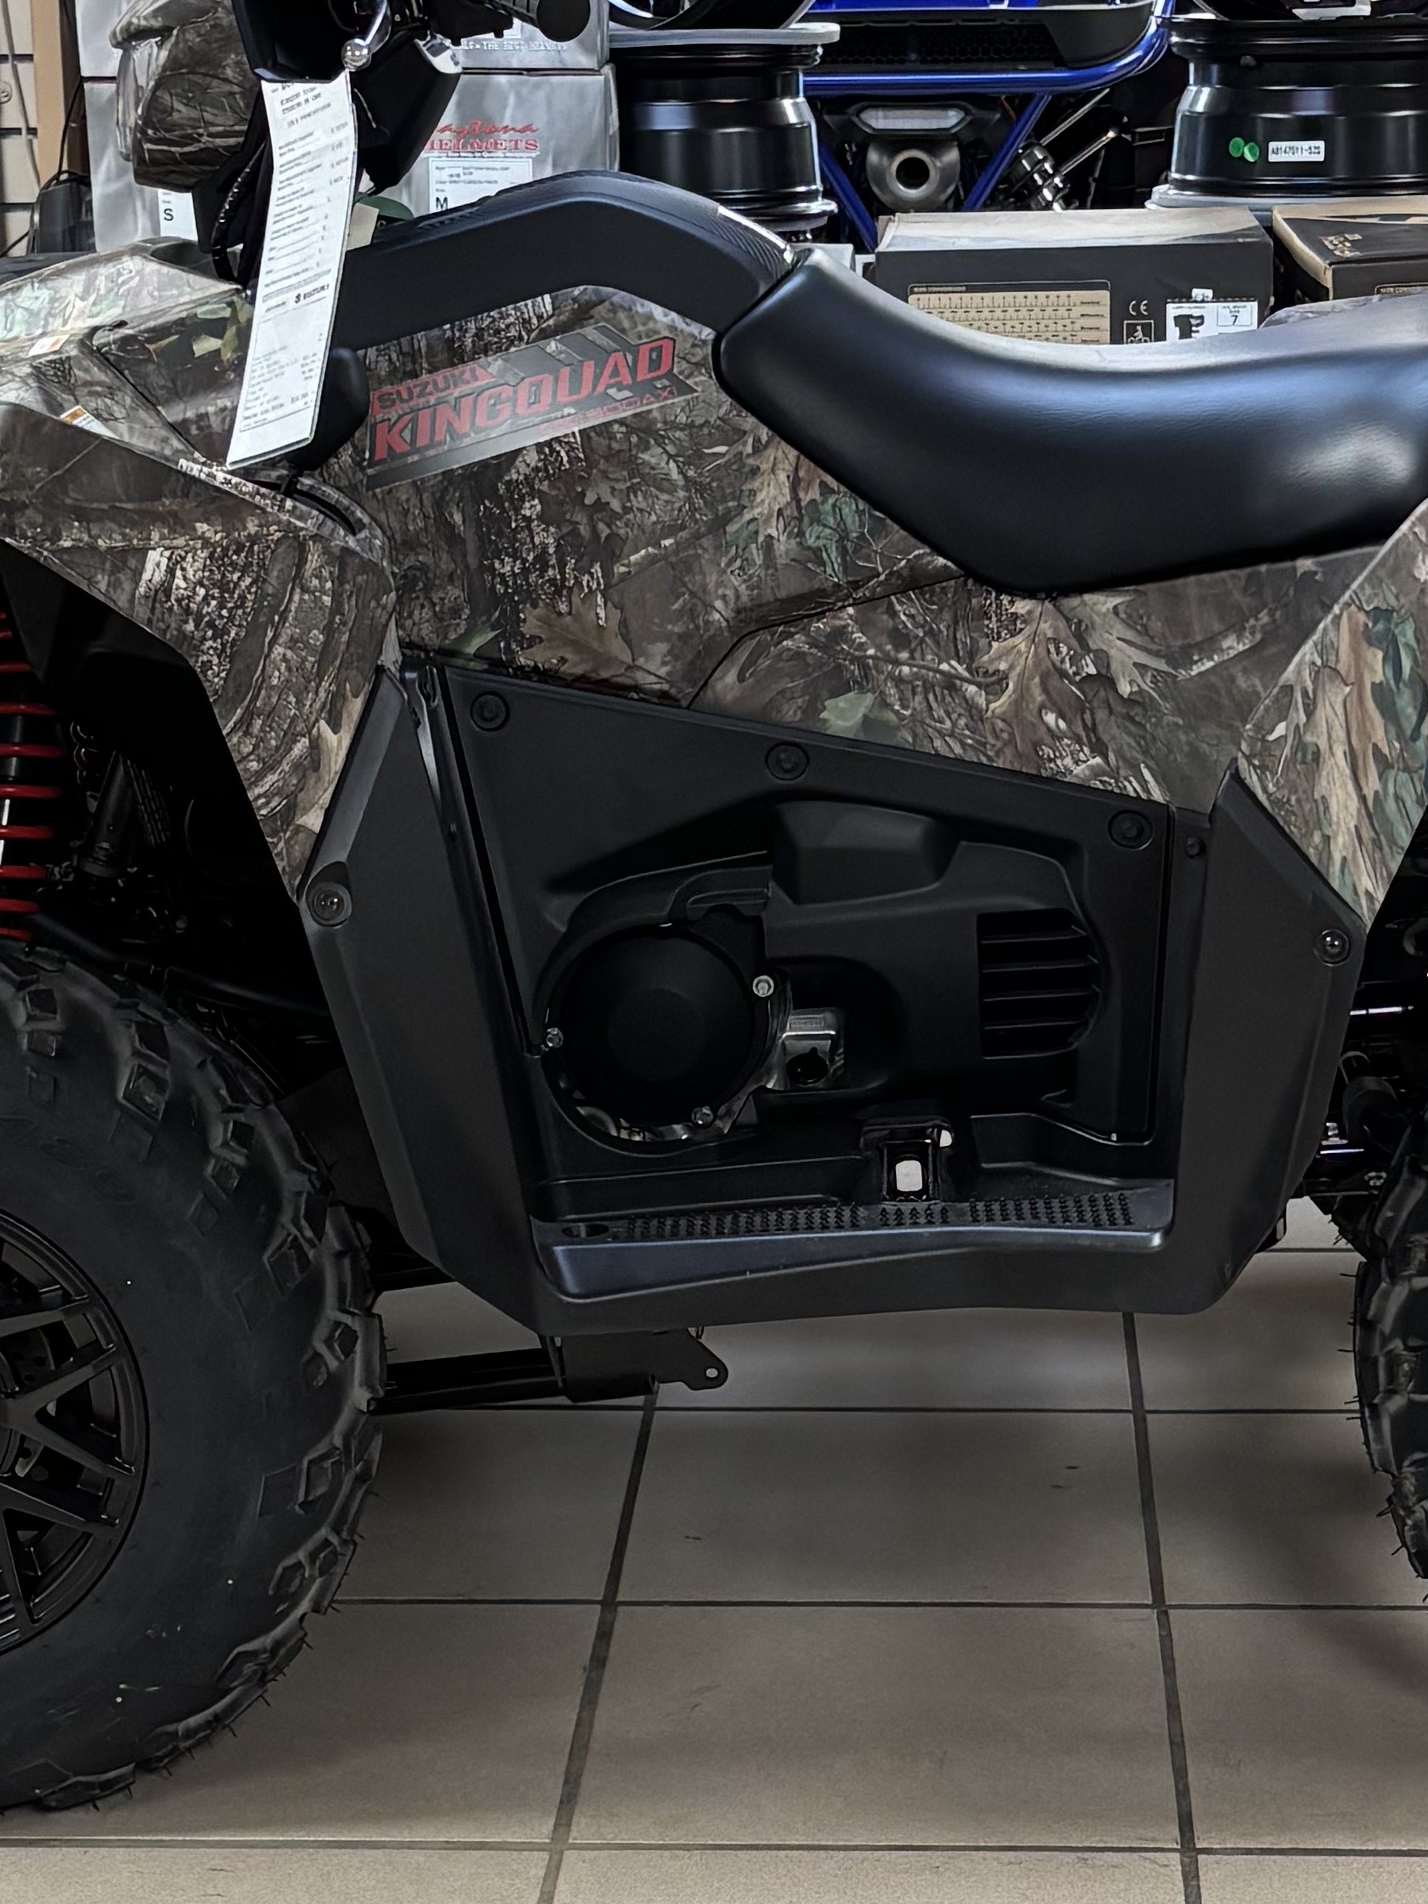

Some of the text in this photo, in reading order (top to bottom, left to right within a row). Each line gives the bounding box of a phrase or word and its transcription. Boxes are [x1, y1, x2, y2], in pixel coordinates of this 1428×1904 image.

[436, 120, 539, 143] aytona
[163, 207, 175, 223] S
[373, 336, 675, 462] KINGQUAD
[376, 365, 489, 410] SUZUKI
